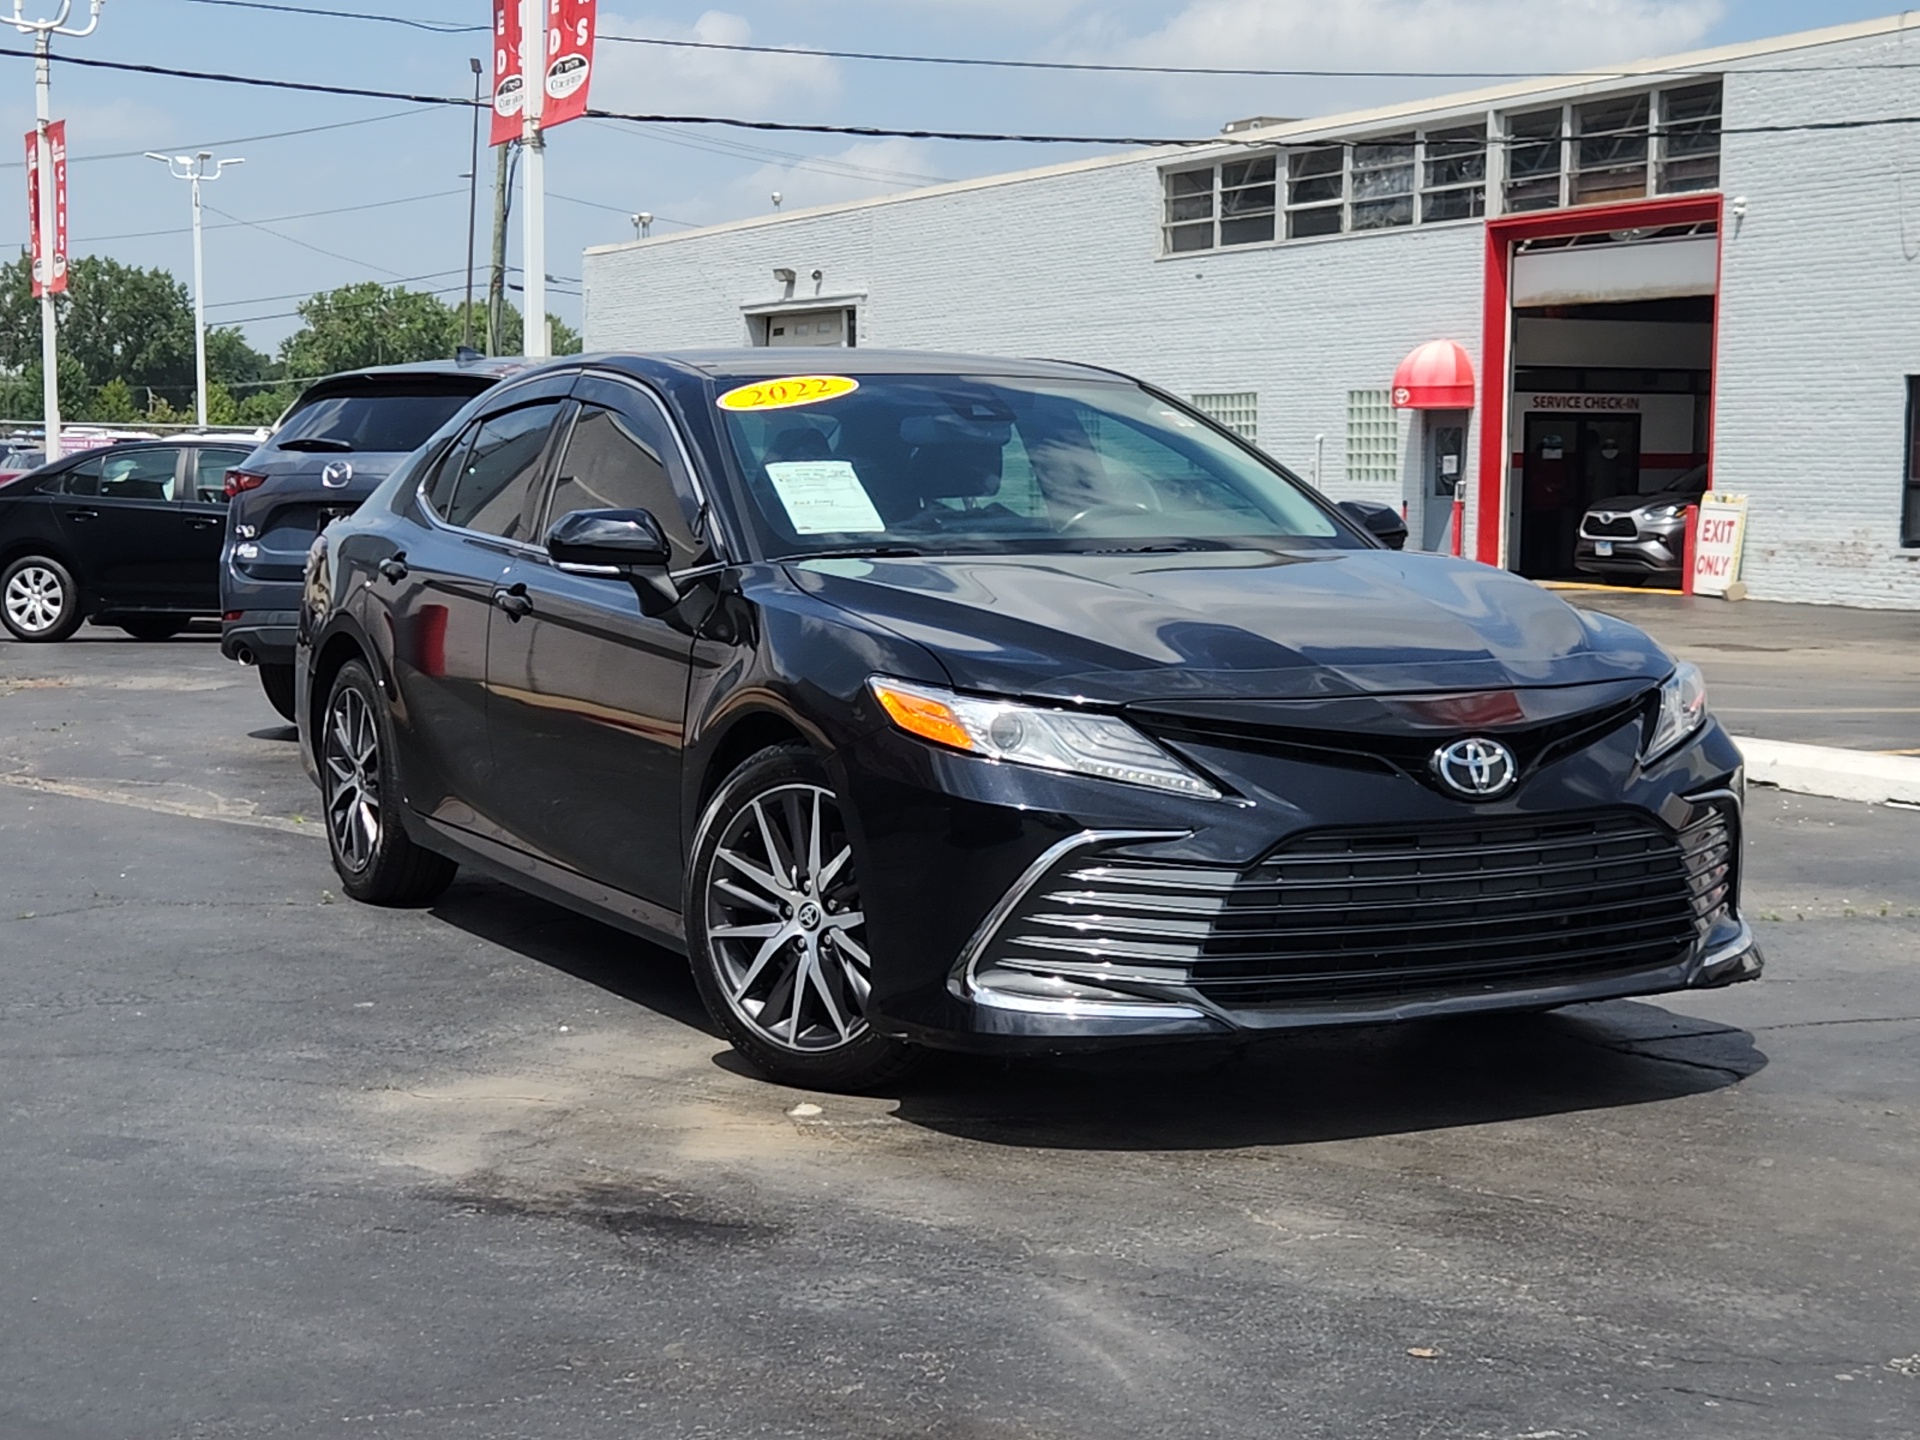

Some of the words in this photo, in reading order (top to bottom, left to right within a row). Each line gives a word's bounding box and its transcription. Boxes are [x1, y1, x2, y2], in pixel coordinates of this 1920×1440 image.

[749, 379, 831, 406] 2022
[1533, 396, 1581, 409] SERVICE
[1584, 396, 1640, 410] CHECK-IN
[1702, 519, 1735, 544] EXIT
[1696, 555, 1730, 577] ONLY
